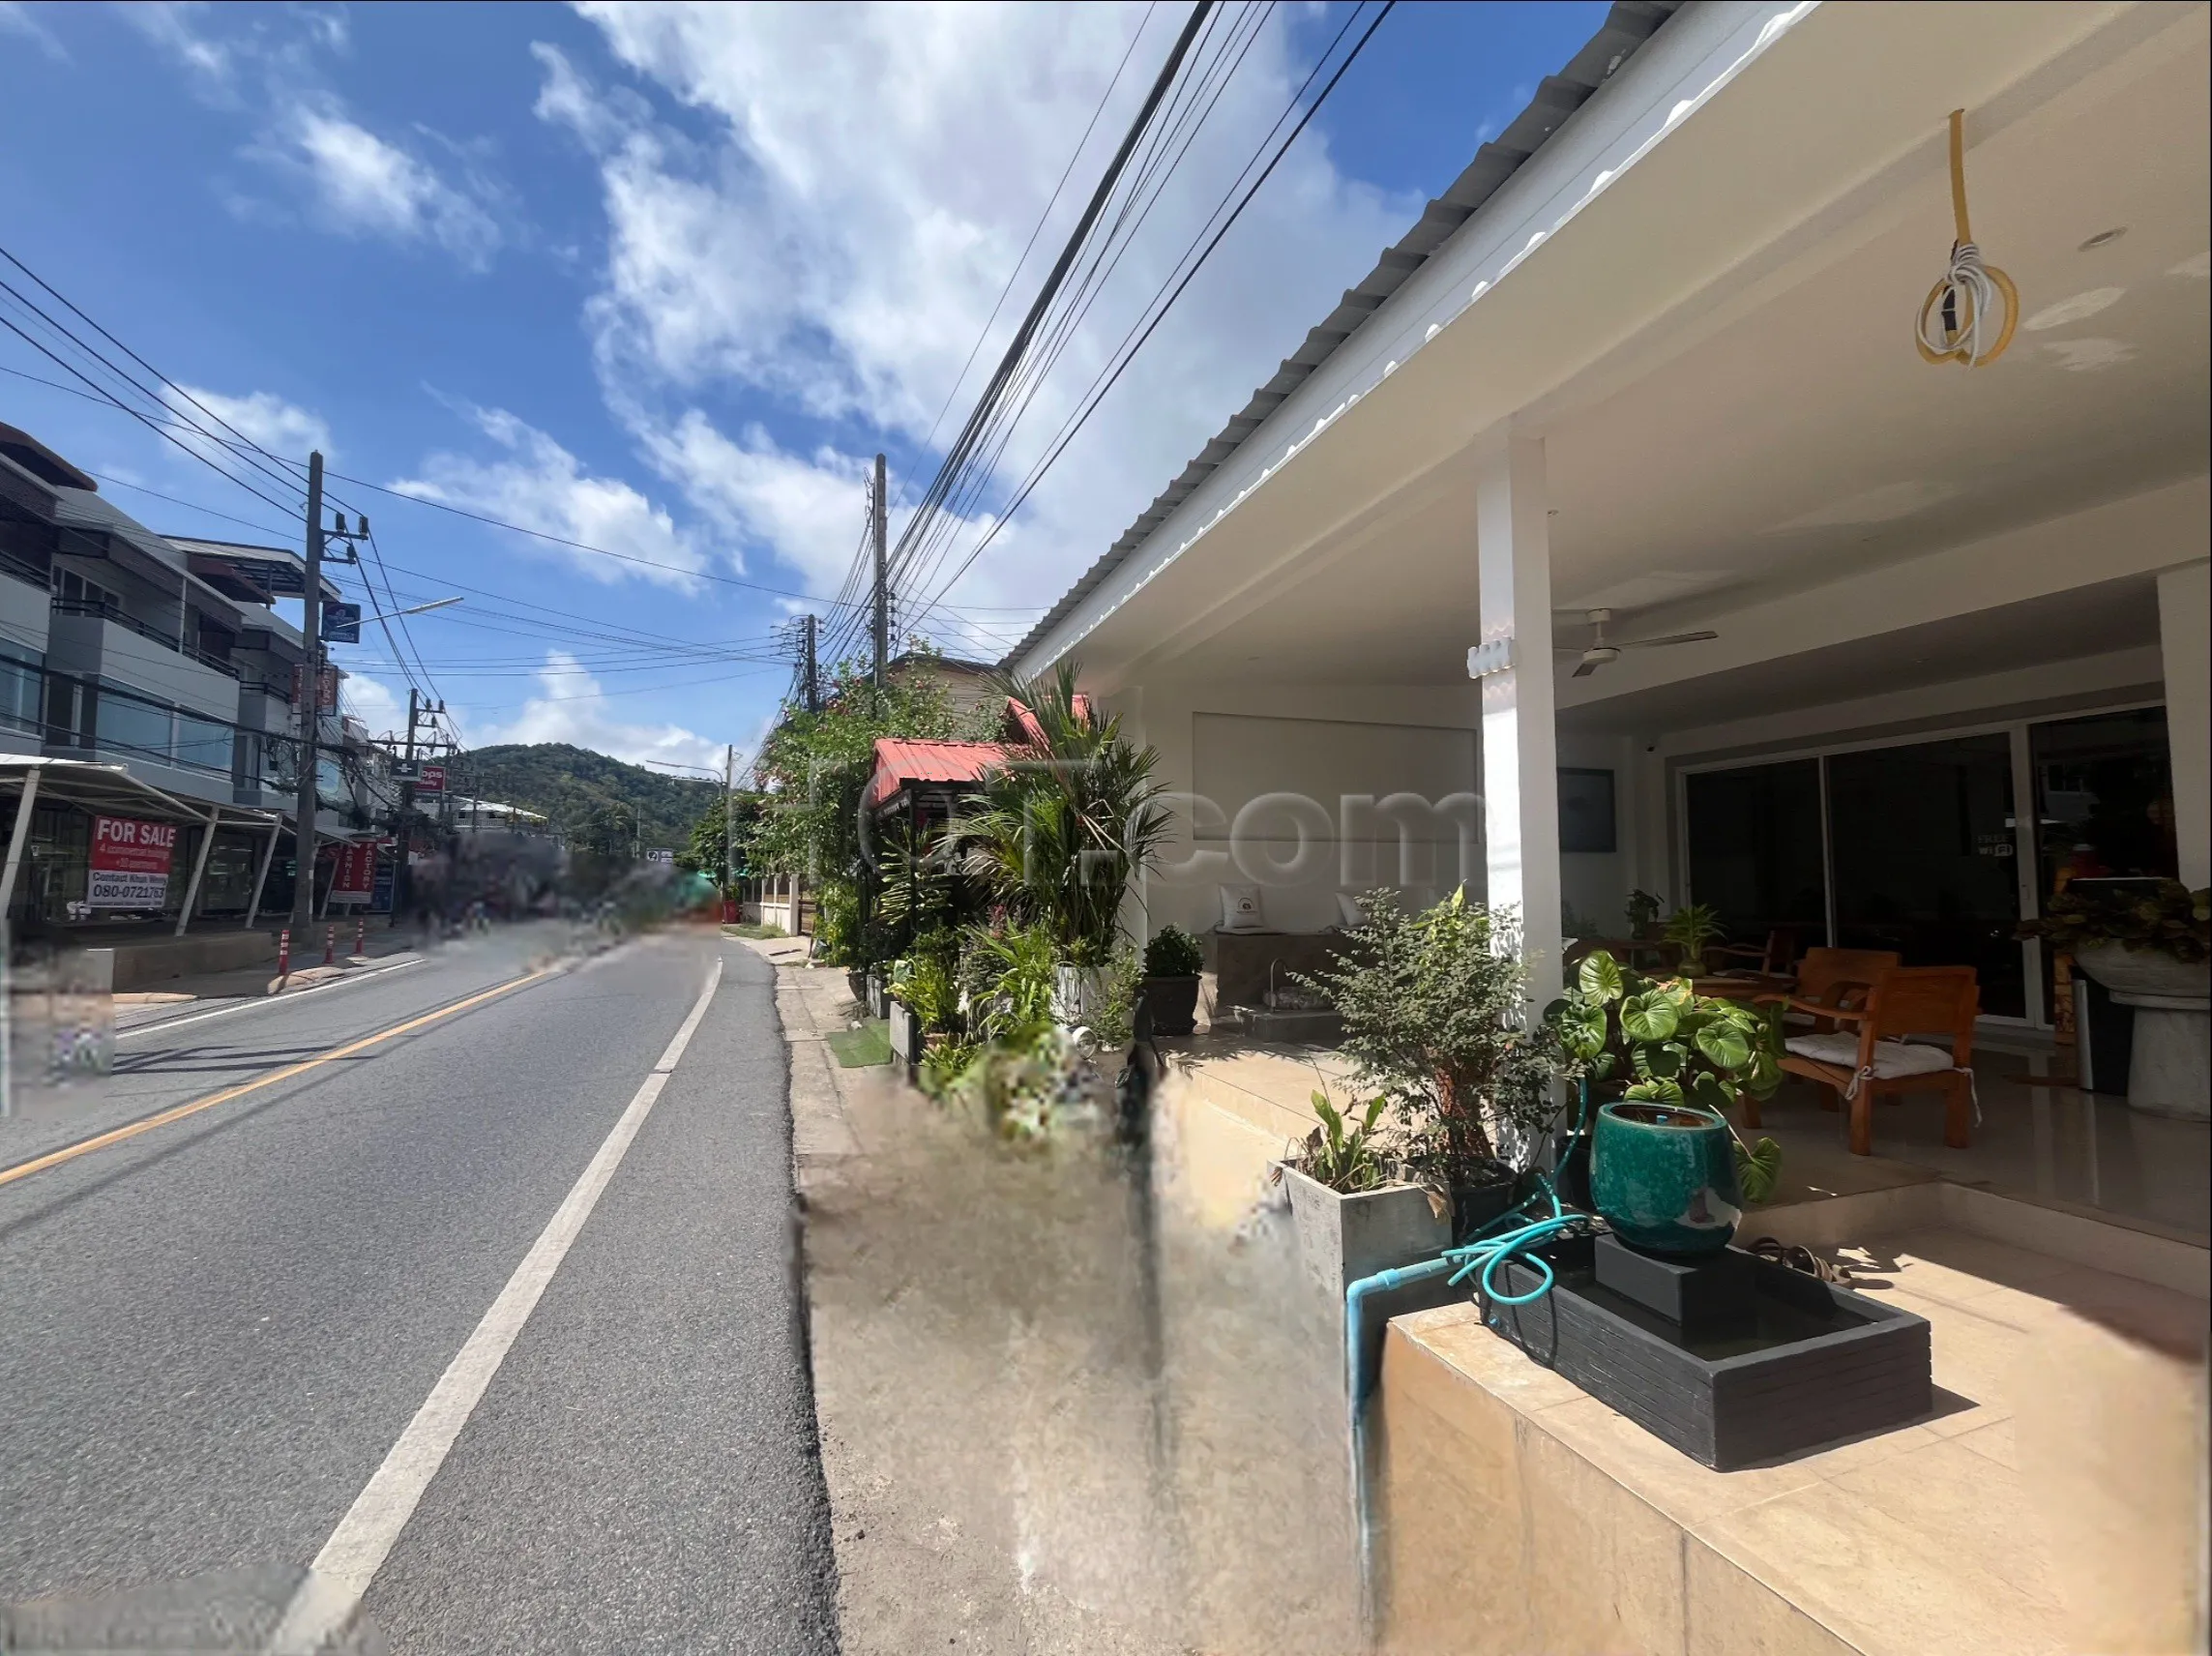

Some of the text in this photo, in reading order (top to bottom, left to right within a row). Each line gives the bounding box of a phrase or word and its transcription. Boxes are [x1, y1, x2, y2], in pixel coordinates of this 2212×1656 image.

[97, 818, 176, 847] FOR SALE
[93, 872, 128, 883] Contact
[341, 848, 354, 888] ASHION
